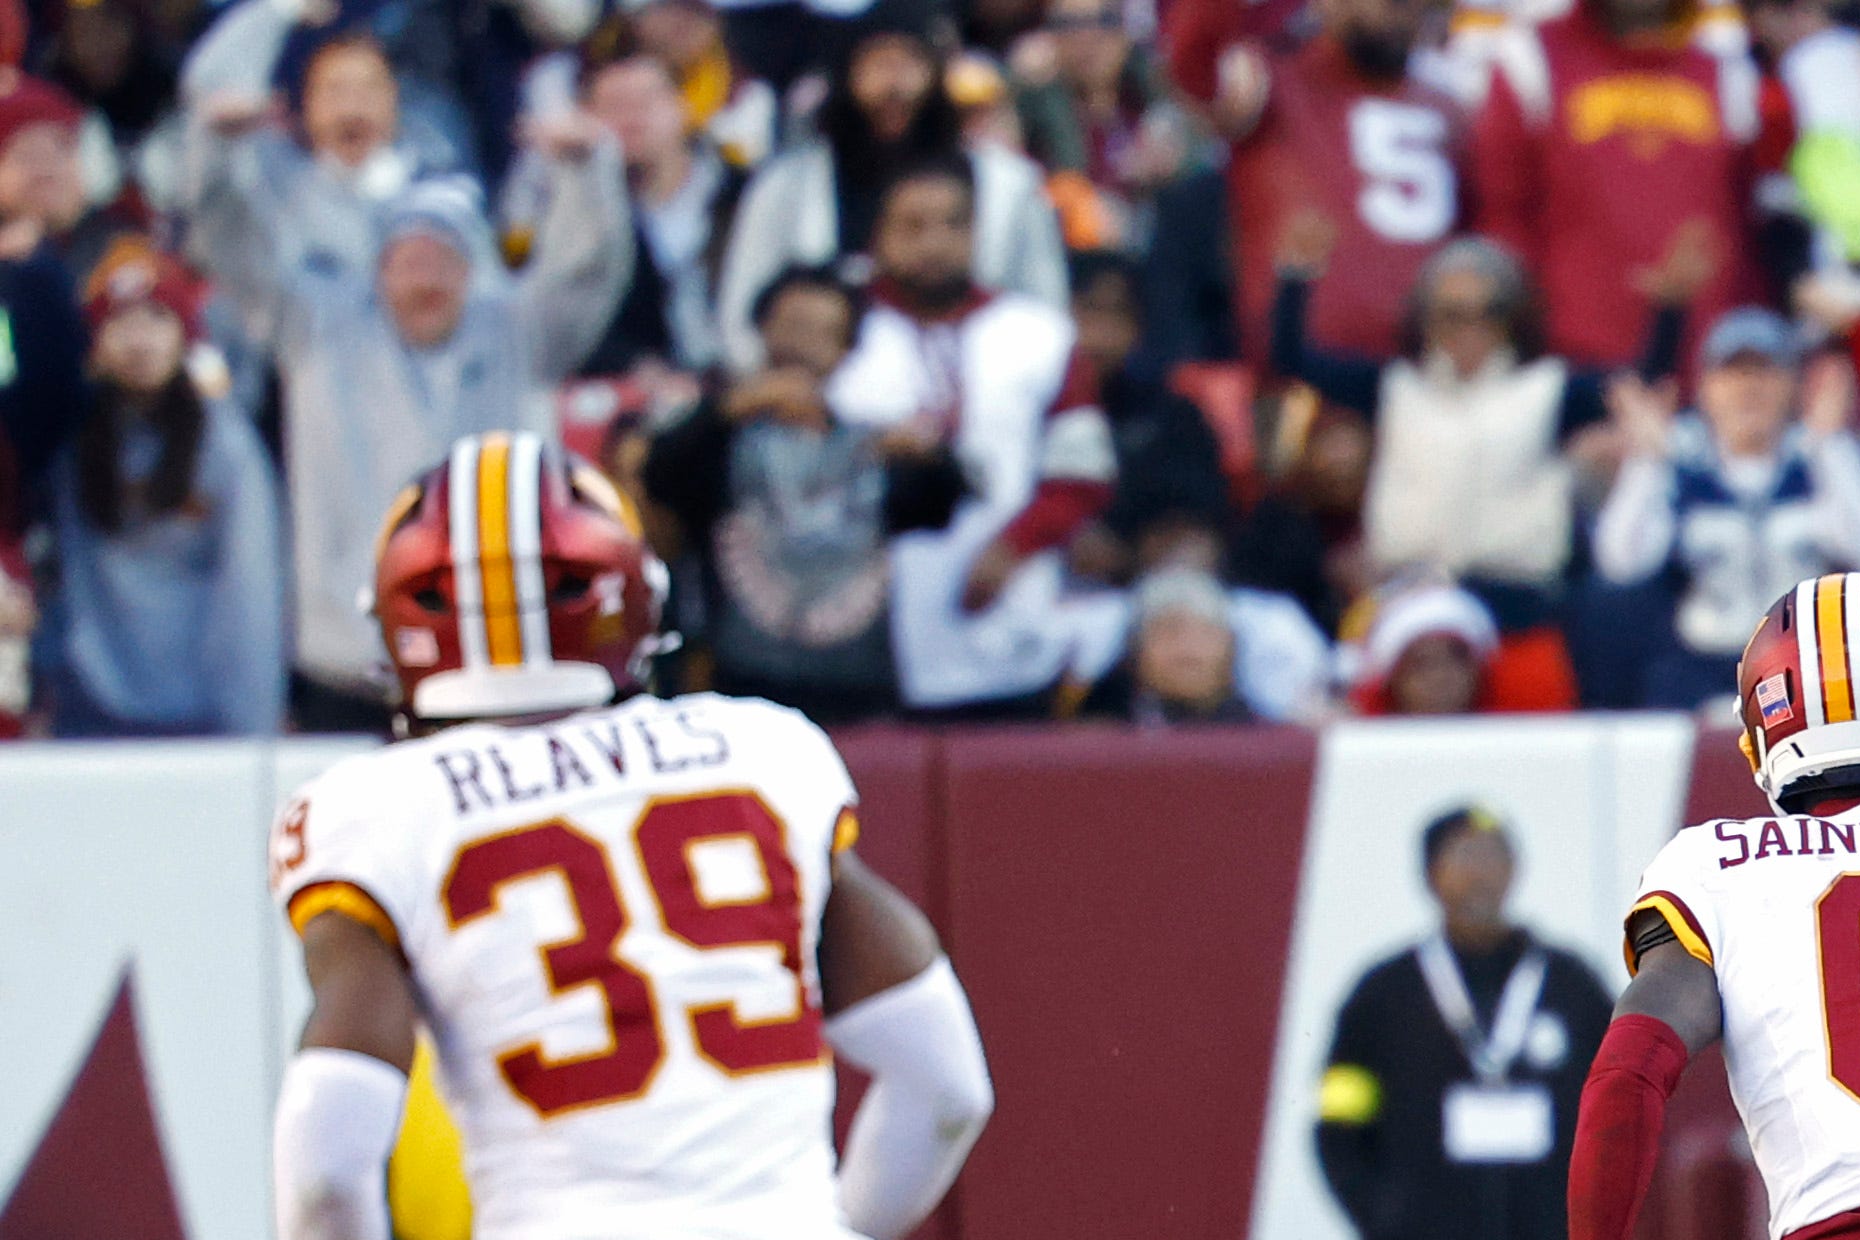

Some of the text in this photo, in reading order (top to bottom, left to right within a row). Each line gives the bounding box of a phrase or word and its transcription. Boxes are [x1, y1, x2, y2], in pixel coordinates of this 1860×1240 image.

[1350, 97, 1457, 242] 5
[434, 711, 731, 815] REAVES
[439, 787, 833, 1123] 39
